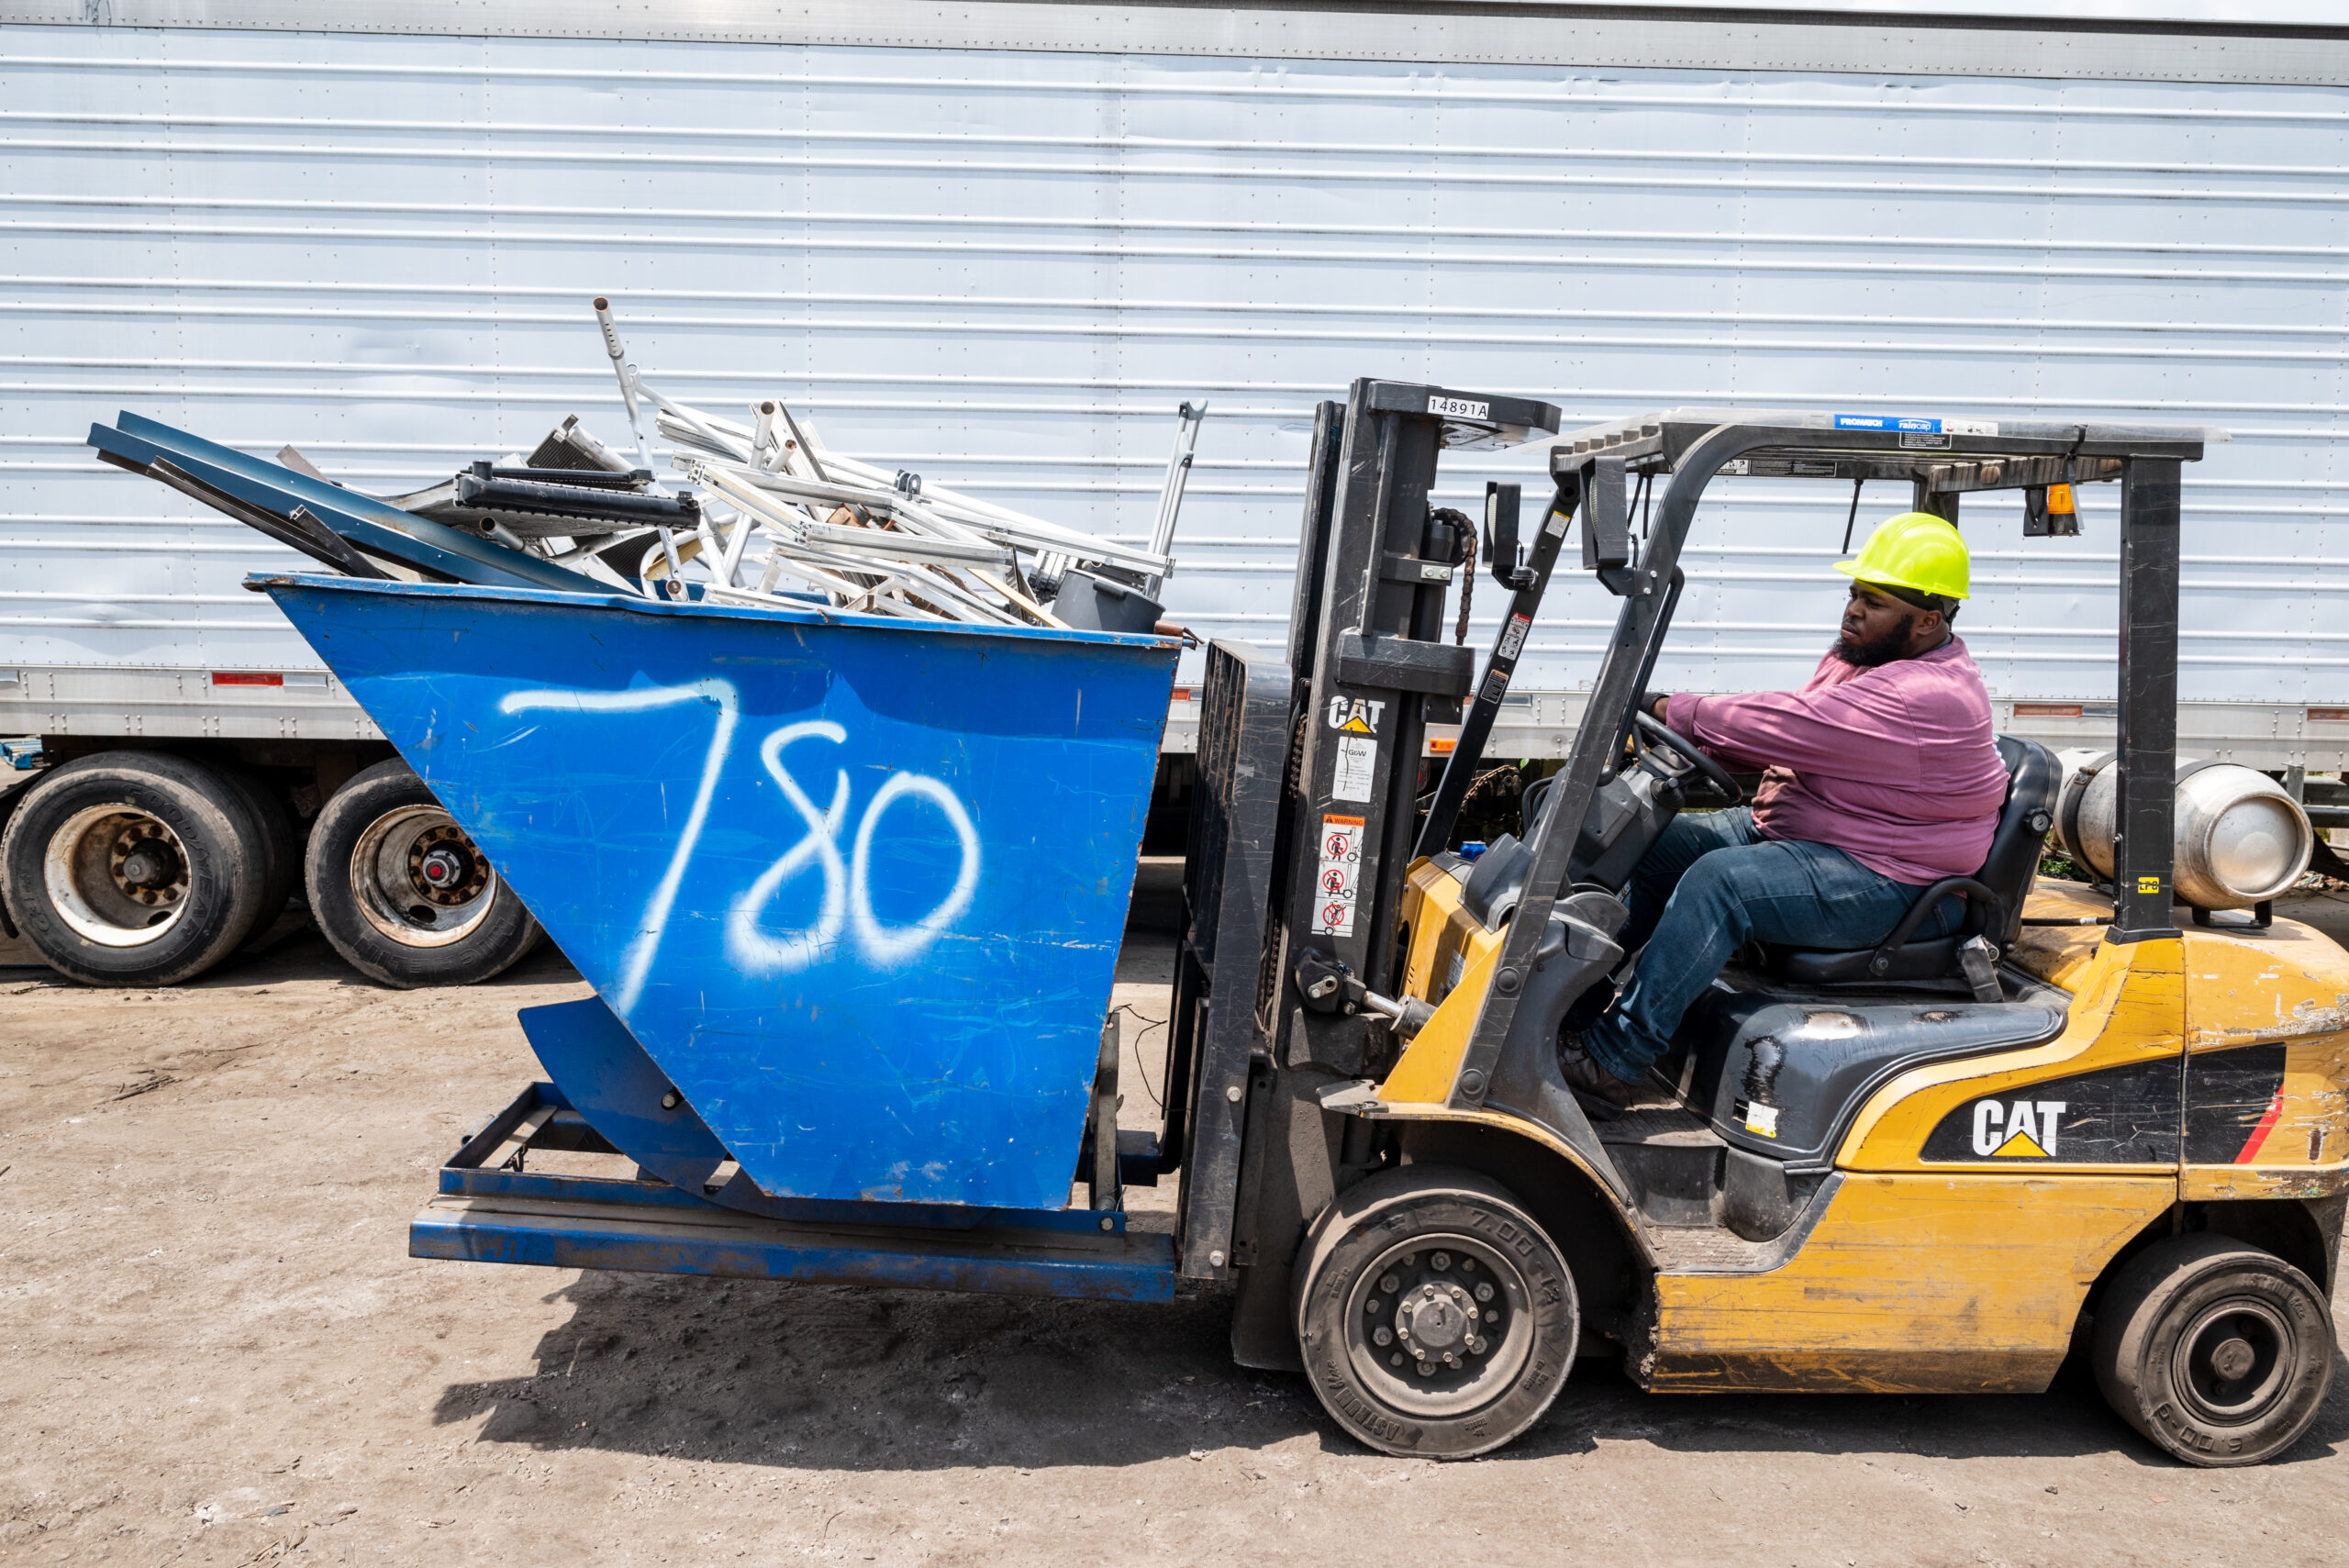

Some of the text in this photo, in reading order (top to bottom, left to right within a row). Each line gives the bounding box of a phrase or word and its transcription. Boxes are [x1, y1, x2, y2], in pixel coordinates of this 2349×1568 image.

[1431, 399, 1486, 417] 14891A
[1898, 420, 1932, 432] raincap
[1328, 695, 1386, 734] CAT
[500, 678, 980, 1017] 780
[1334, 817, 1364, 828] WARNING
[122, 784, 215, 940] GOODYEAR
[351, 917, 516, 974] MICHELIN
[1972, 1099, 2067, 1157] CAT
[1333, 1388, 1404, 1441] ASTRUM
